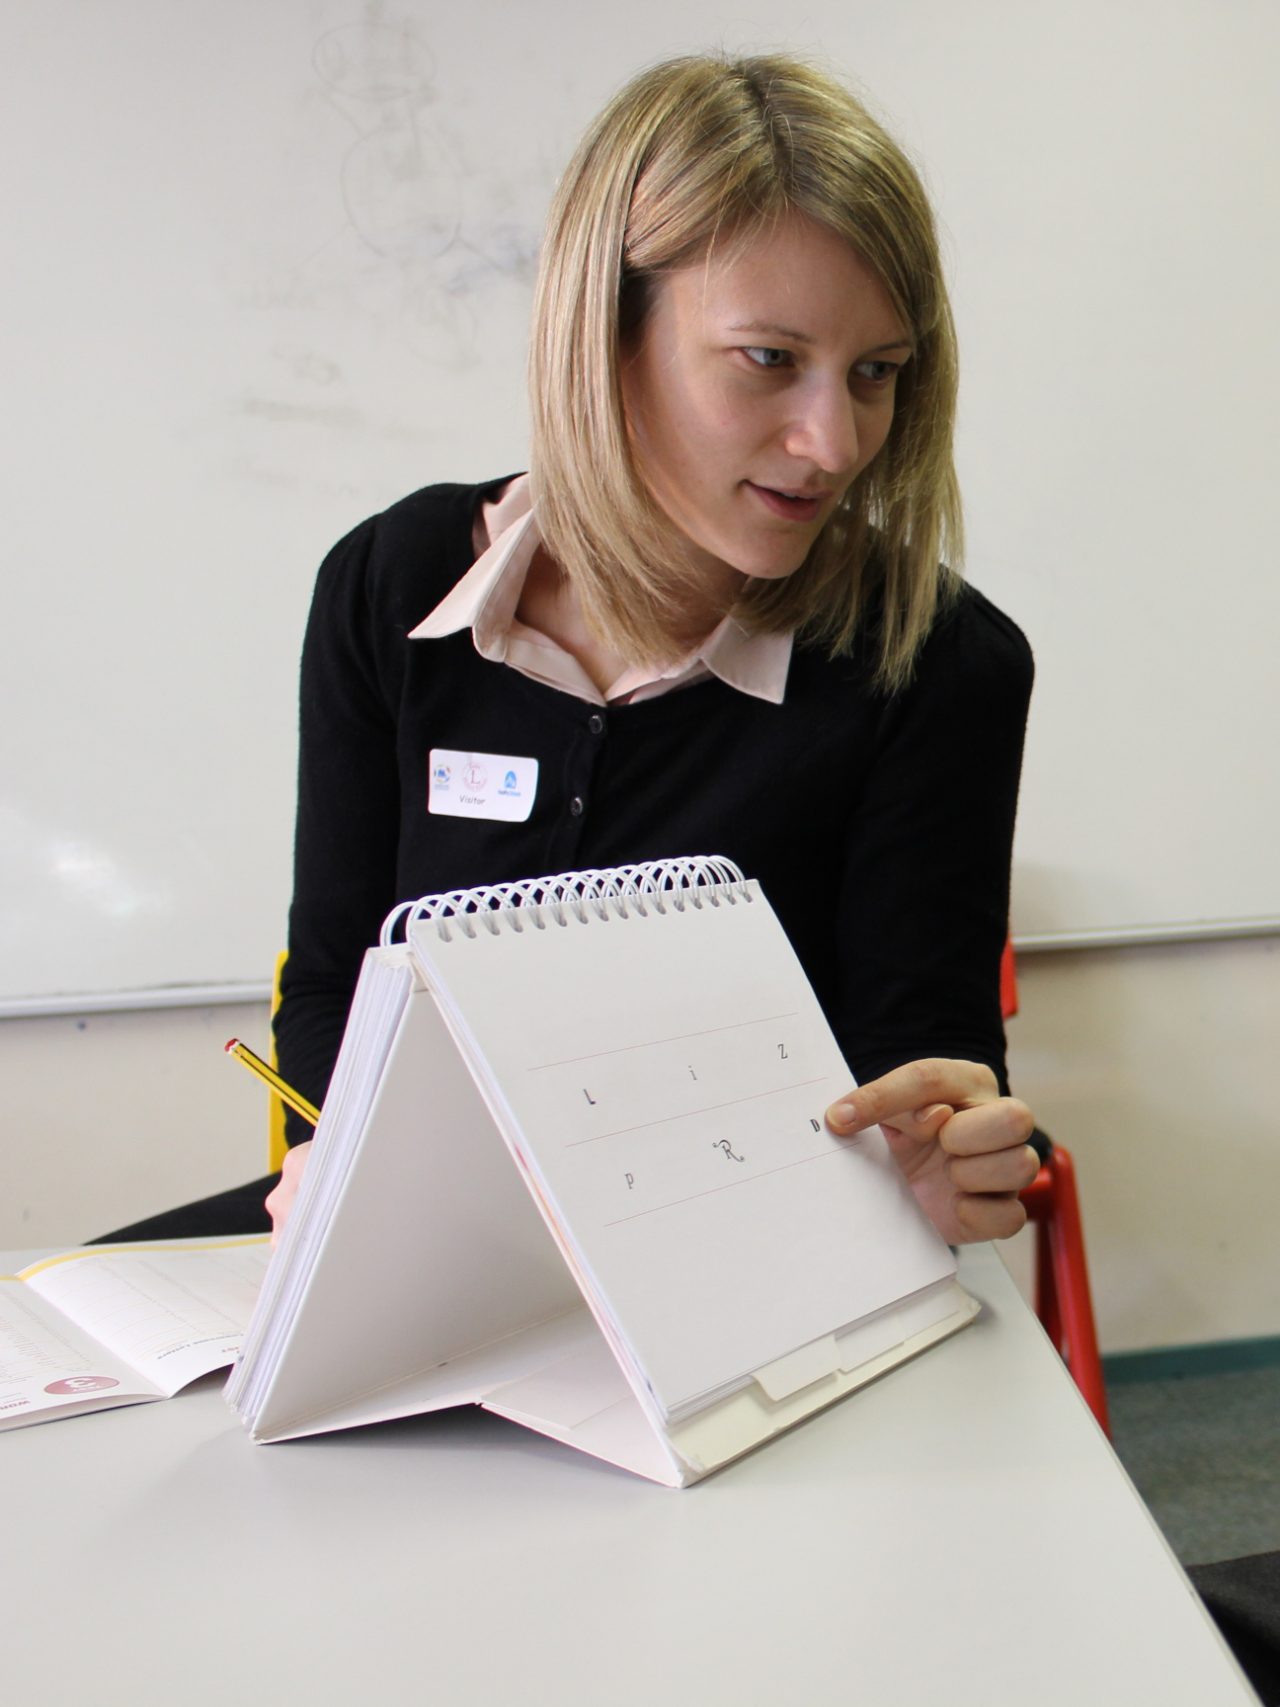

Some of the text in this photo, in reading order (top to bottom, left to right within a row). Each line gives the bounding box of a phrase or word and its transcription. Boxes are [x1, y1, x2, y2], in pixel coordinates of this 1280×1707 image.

[459, 795, 486, 806] Visitor
[584, 1088, 596, 1105] L
[712, 1139, 745, 1163] R
